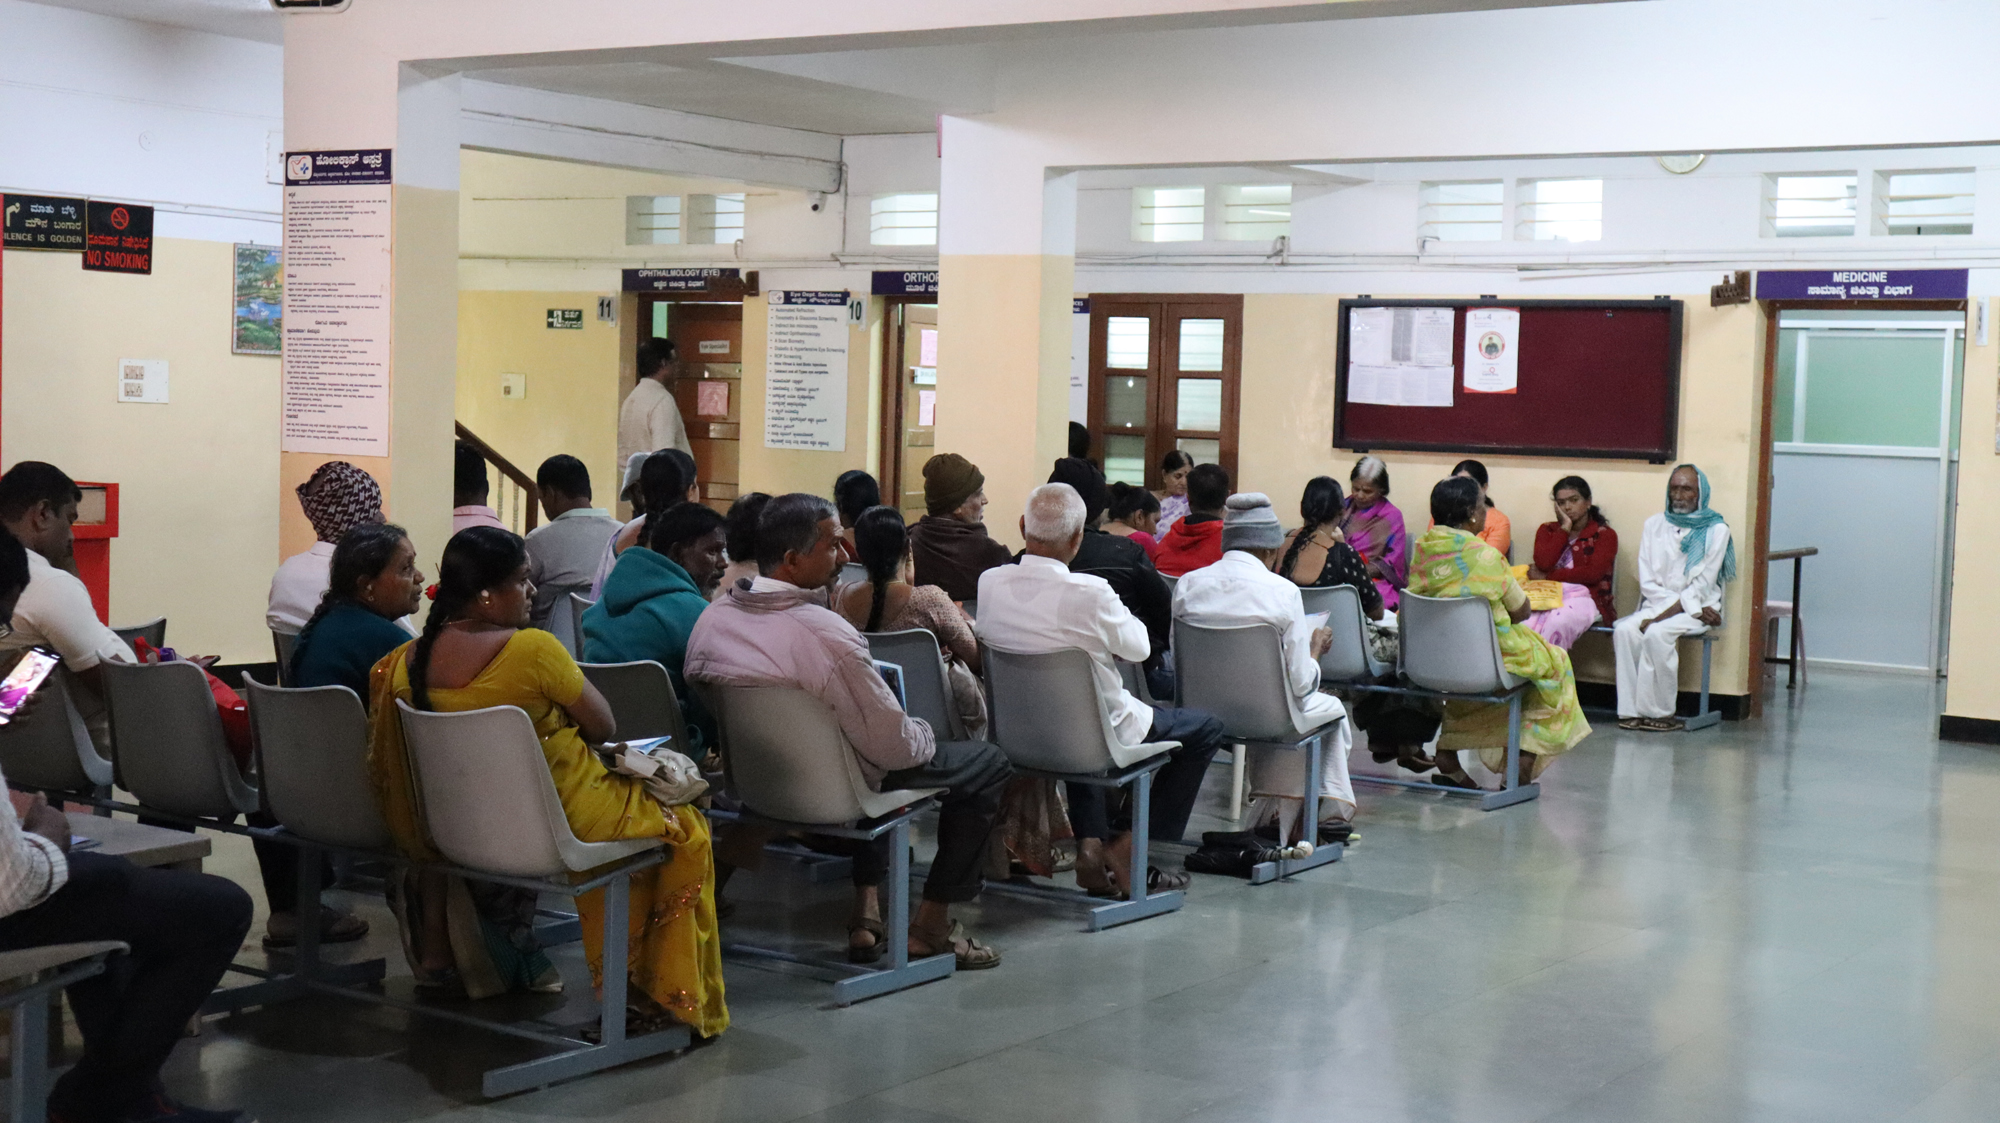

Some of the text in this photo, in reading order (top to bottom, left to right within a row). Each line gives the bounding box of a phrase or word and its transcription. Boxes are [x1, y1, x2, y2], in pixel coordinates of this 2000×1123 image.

[30, 203, 77, 220] ಮಾತು ಬೆಳ್ಳಿ
[25, 217, 82, 230] ಮೌನ ಬಂಗಾರ
[4, 232, 82, 243] ILENCE IS GOLDEN
[87, 250, 149, 270] NO SMOKING
[638, 268, 720, 277] OPHTHALMOLOGY (EYE)
[1833, 272, 1888, 282] MEDICINE
[599, 298, 611, 318] 11
[849, 300, 862, 320] 10
